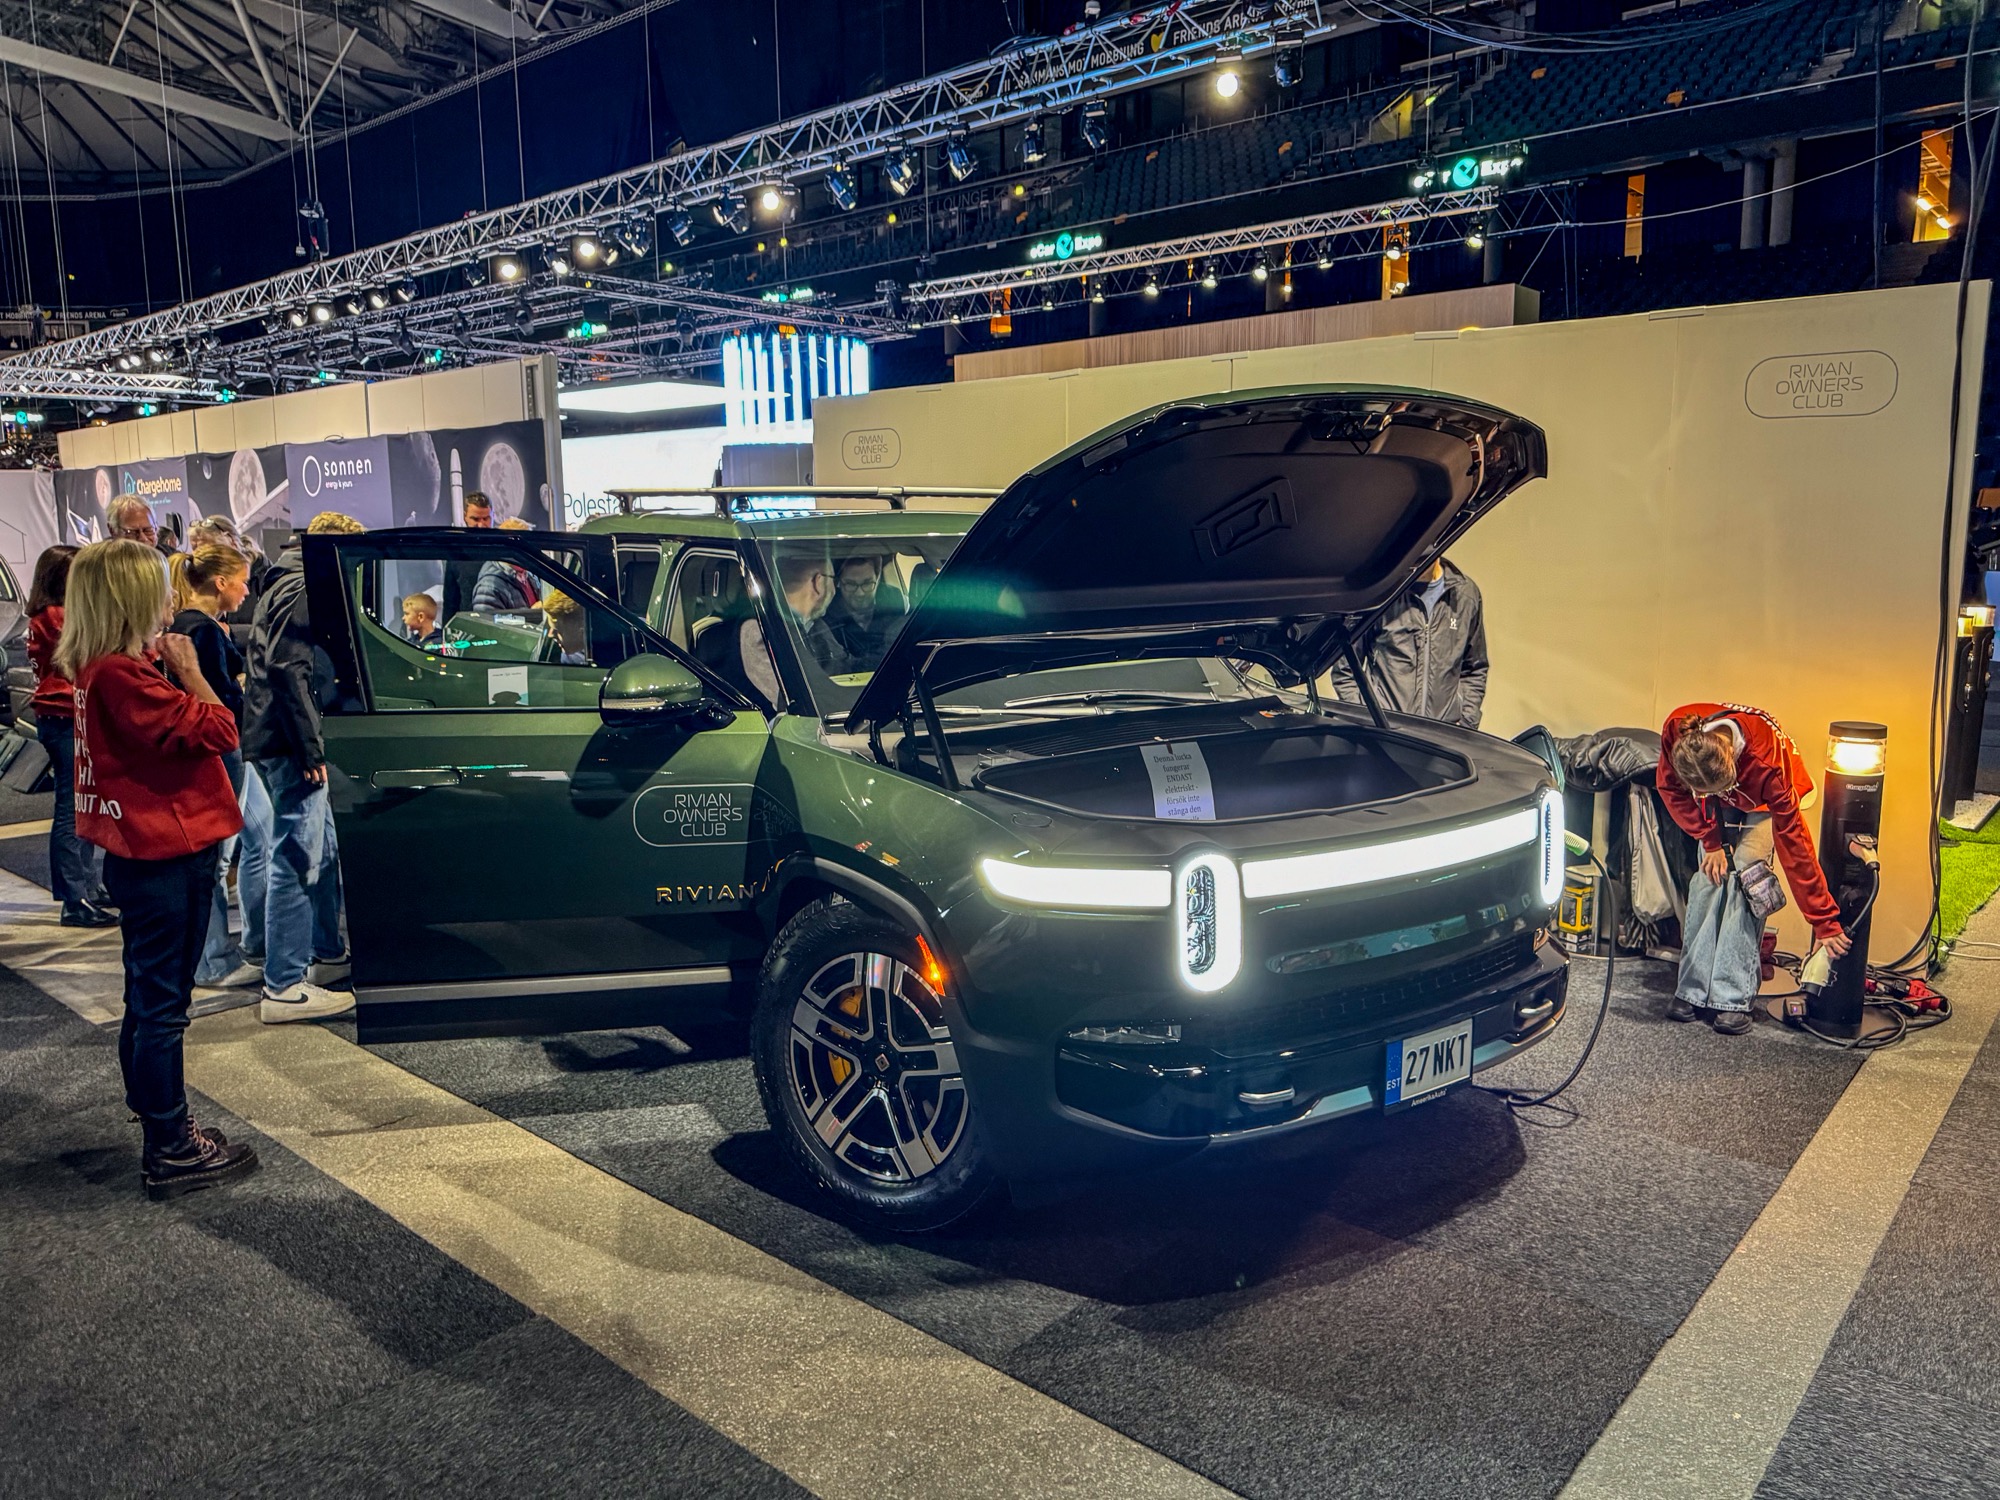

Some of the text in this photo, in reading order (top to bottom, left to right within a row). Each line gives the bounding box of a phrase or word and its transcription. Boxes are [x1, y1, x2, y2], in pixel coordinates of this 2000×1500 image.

[1173, 18, 1221, 46] FRIENDS
[900, 203, 933, 221] WEST
[1789, 361, 1852, 379] RIVIAN
[1775, 376, 1863, 395] OWNERS
[1792, 393, 1844, 410] CLUB
[858, 434, 884, 445] RIVIAN
[853, 443, 889, 456] OWNERS
[860, 453, 882, 465] CLUB
[323, 458, 372, 477] sonnen
[136, 476, 182, 498] Chargehome
[1153, 753, 1192, 763] Denna lucka
[1162, 764, 1190, 773] fungerar
[1166, 773, 1193, 783] ENDAST
[1165, 783, 1195, 794] elektriskt
[674, 792, 731, 808] RIVIAN
[1166, 794, 1200, 805] försök inte
[663, 807, 743, 823] OWNERS
[1189, 805, 1202, 813] den
[680, 822, 727, 837] CLUB
[656, 883, 755, 903] RIVIAN
[1405, 1031, 1469, 1085] 27 NKT
[1386, 1077, 1402, 1091] EST
